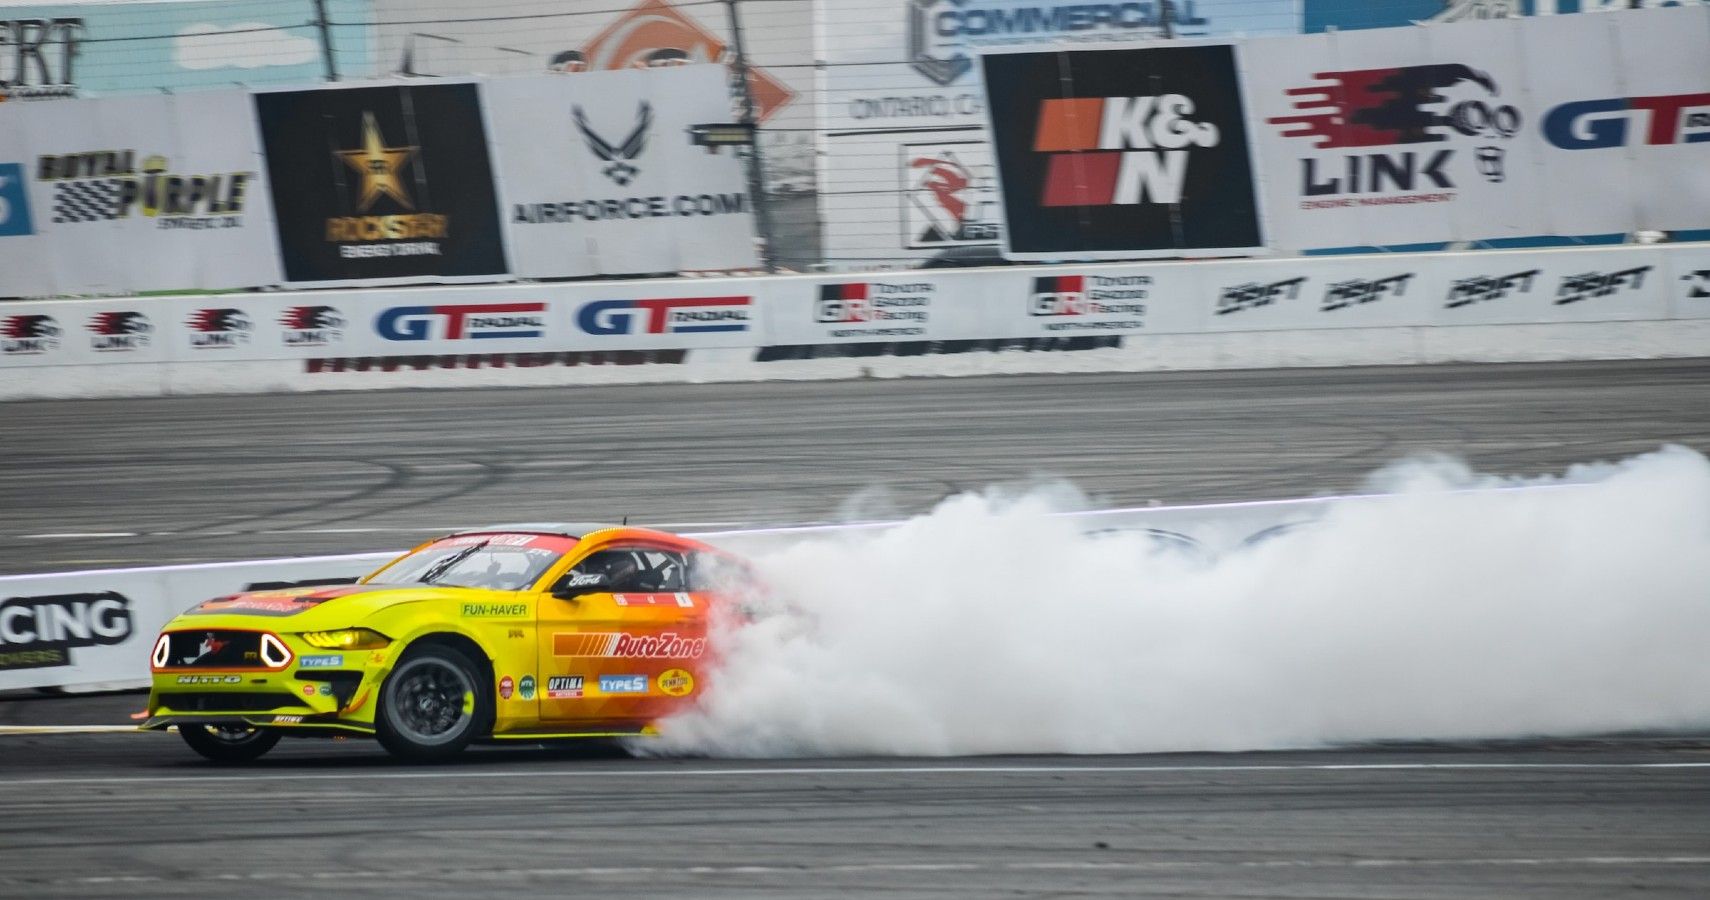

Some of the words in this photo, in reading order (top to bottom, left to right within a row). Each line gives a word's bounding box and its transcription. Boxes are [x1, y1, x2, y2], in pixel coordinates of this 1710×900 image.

[0, 17, 84, 88] RT
[1098, 93, 1221, 150] K&
[1542, 96, 1682, 150] GT
[38, 149, 135, 182] ROYAL
[1112, 150, 1190, 205] N
[1298, 149, 1458, 197] LINK
[511, 192, 751, 224] AIRFORCE.COM
[372, 303, 467, 342] GT
[574, 298, 669, 336] GT
[569, 573, 602, 587] Ford
[0, 598, 129, 646] CING
[463, 604, 528, 616] FUN-HAVER
[612, 632, 705, 658] AutoZone
[177, 675, 242, 685] NITTO
[548, 677, 584, 690] OPTIMA
